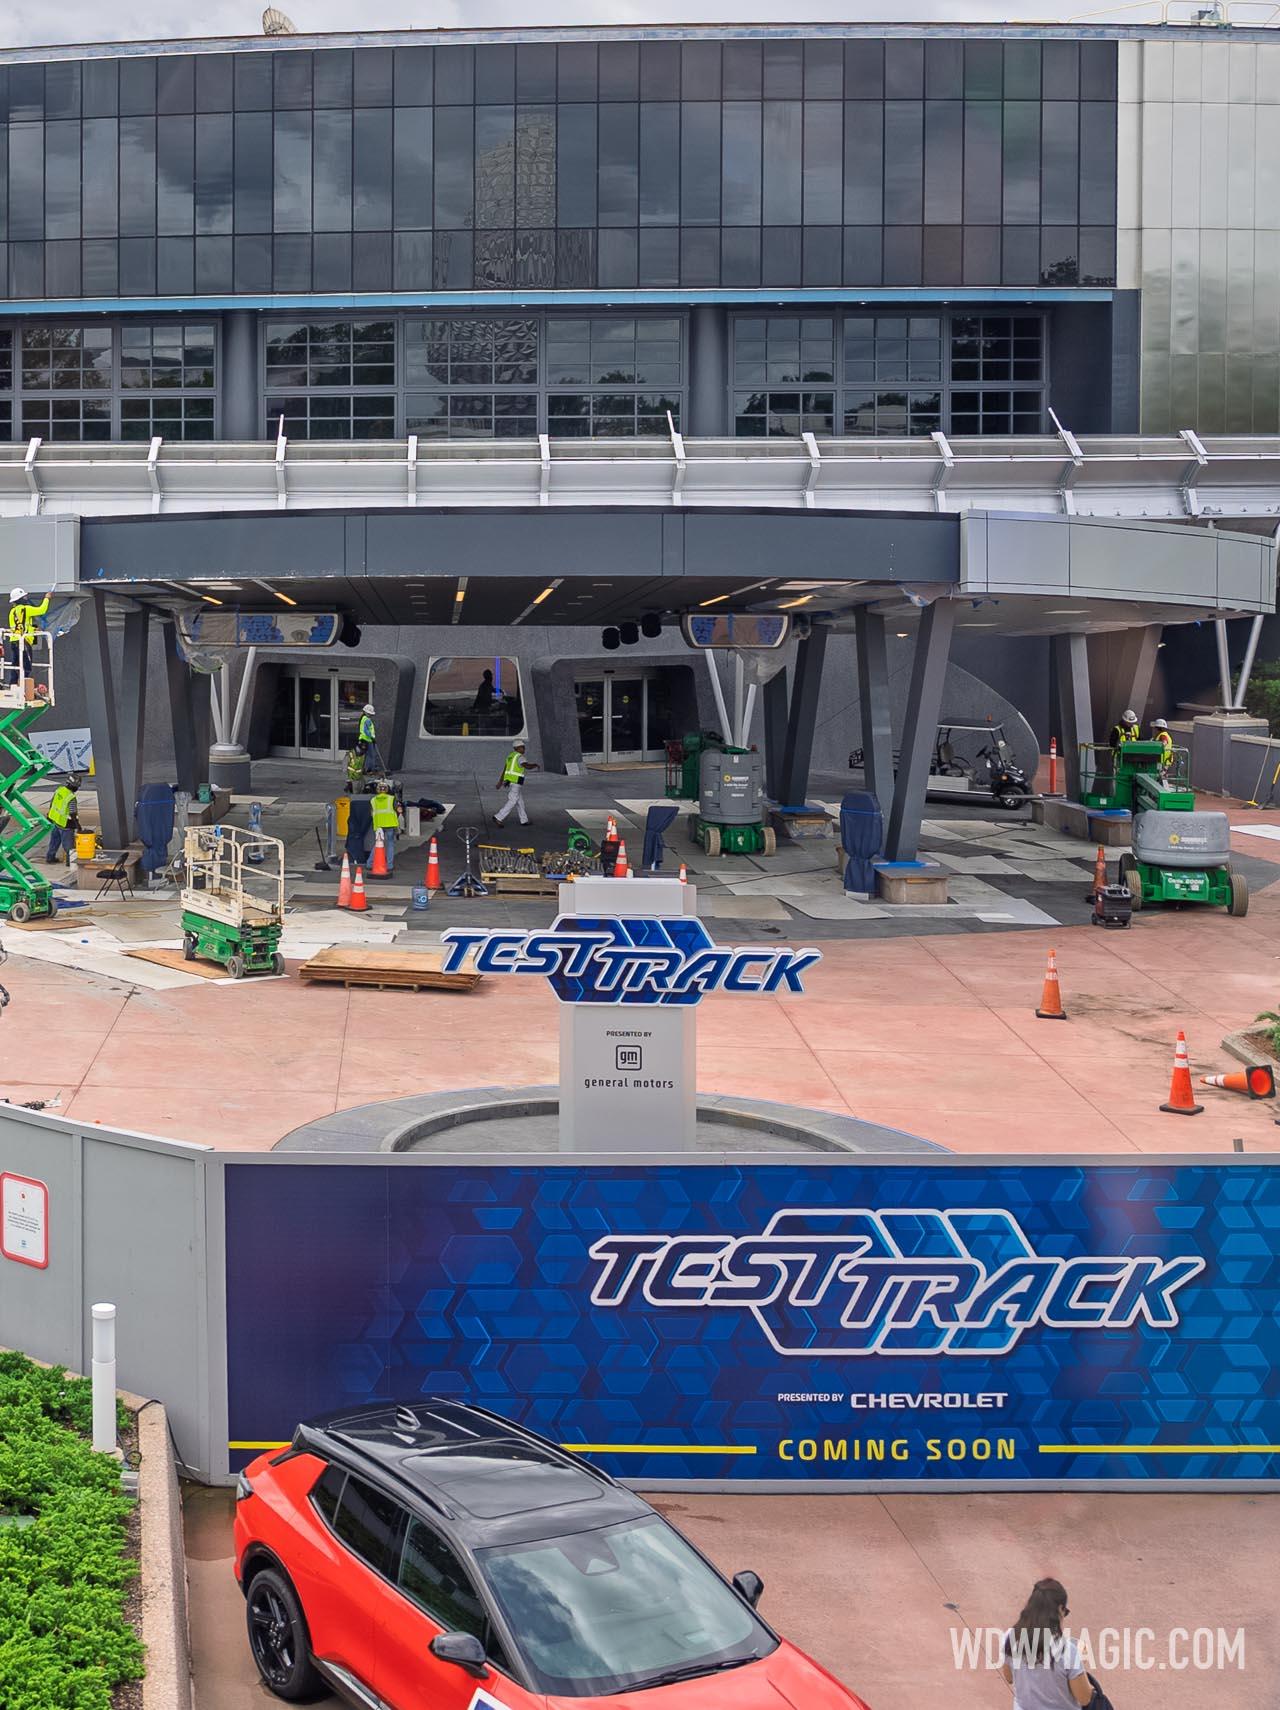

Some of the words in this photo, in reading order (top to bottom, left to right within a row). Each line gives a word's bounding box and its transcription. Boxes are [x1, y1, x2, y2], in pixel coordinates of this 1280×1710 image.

[440, 927, 615, 976] TEST
[594, 947, 823, 993] TRACK
[606, 1030, 642, 1038] PRESENTED
[620, 1051, 638, 1065] gm
[584, 1078, 628, 1089] general
[633, 1079, 674, 1089] motors
[589, 1235, 872, 1306] TEST
[838, 1256, 1206, 1328] TRACK
[778, 1393, 829, 1402] PRESENTED
[831, 1393, 844, 1402] BY
[850, 1393, 1008, 1408] CHEVROLET
[778, 1439, 909, 1461] COMING
[926, 1438, 1015, 1460] SOON
